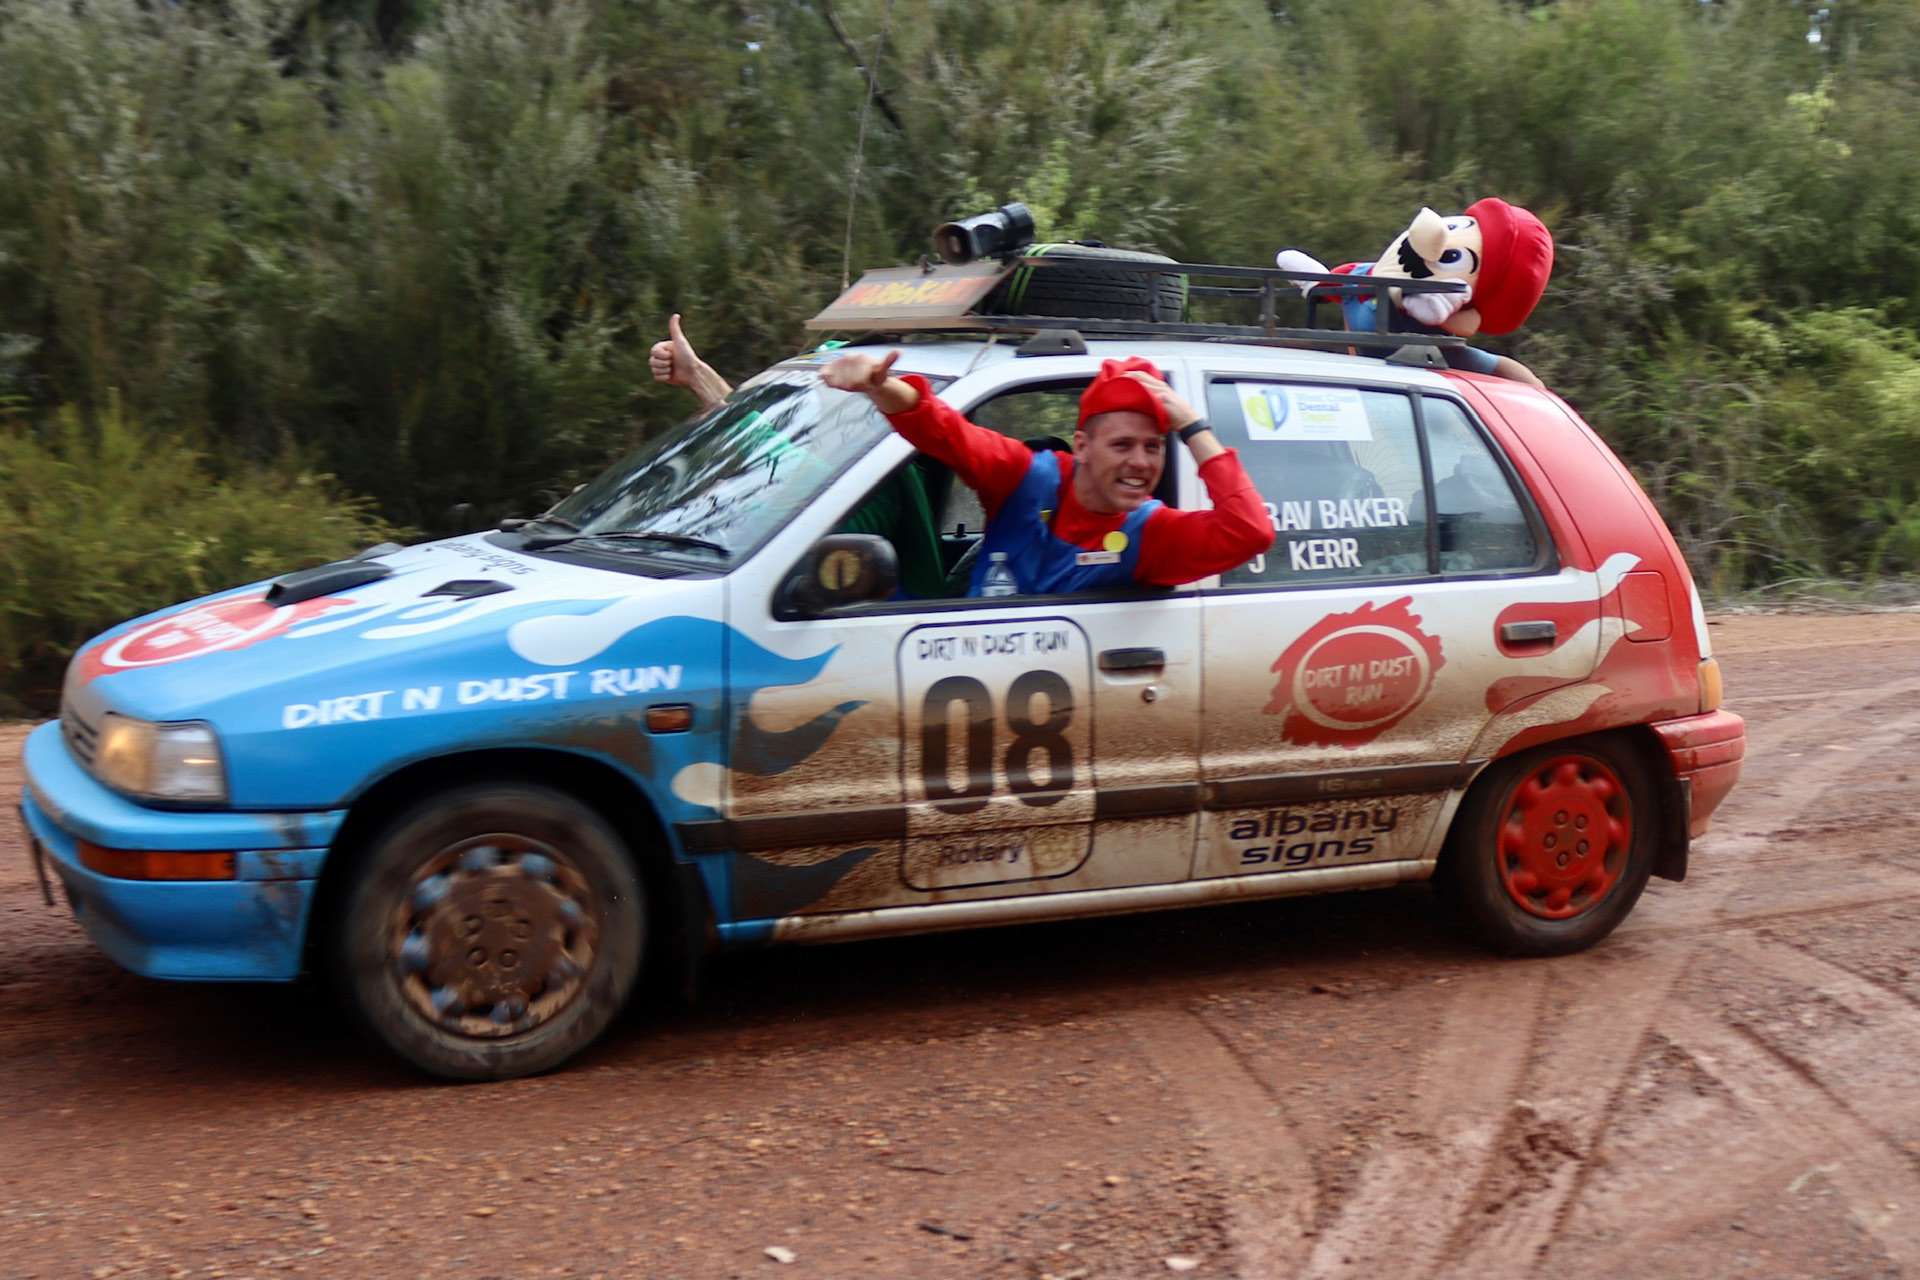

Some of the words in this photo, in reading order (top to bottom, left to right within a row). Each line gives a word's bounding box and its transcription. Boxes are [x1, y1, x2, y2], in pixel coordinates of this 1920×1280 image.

[1261, 500, 1312, 532] RAV
[1317, 497, 1409, 530] BAKER
[1288, 537, 1362, 571] KERR
[917, 636, 958, 661] DIRT
[961, 636, 978, 657] N
[982, 632, 1026, 656] DUST
[1032, 630, 1069, 655] RUN
[1304, 664, 1347, 690] DIRT
[1349, 663, 1365, 682] N
[1369, 655, 1415, 680] DUST
[281, 690, 395, 730] DIRT
[402, 686, 443, 711] N
[456, 671, 579, 705] DUST
[588, 664, 683, 697] RUN
[1345, 683, 1384, 706] RUN
[921, 669, 1074, 815] 08
[1230, 806, 1399, 840] albany
[1240, 837, 1376, 867] signs
